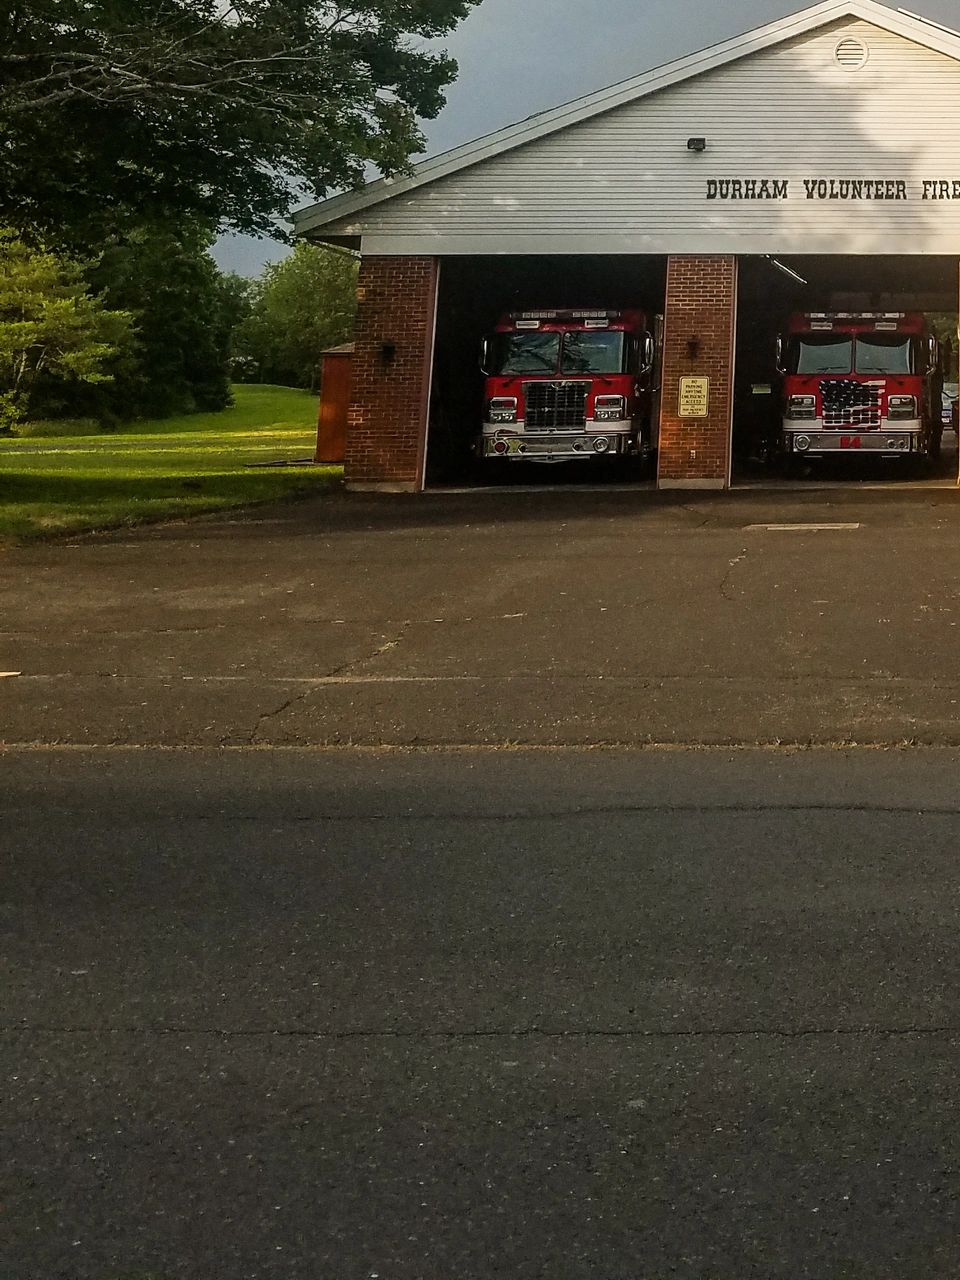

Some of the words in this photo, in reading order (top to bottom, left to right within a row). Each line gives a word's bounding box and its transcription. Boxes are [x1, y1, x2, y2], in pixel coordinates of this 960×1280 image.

[706, 179, 788, 200] DURHAM
[803, 179, 907, 200] VOLUNTEER
[922, 180, 960, 200] FIRE
